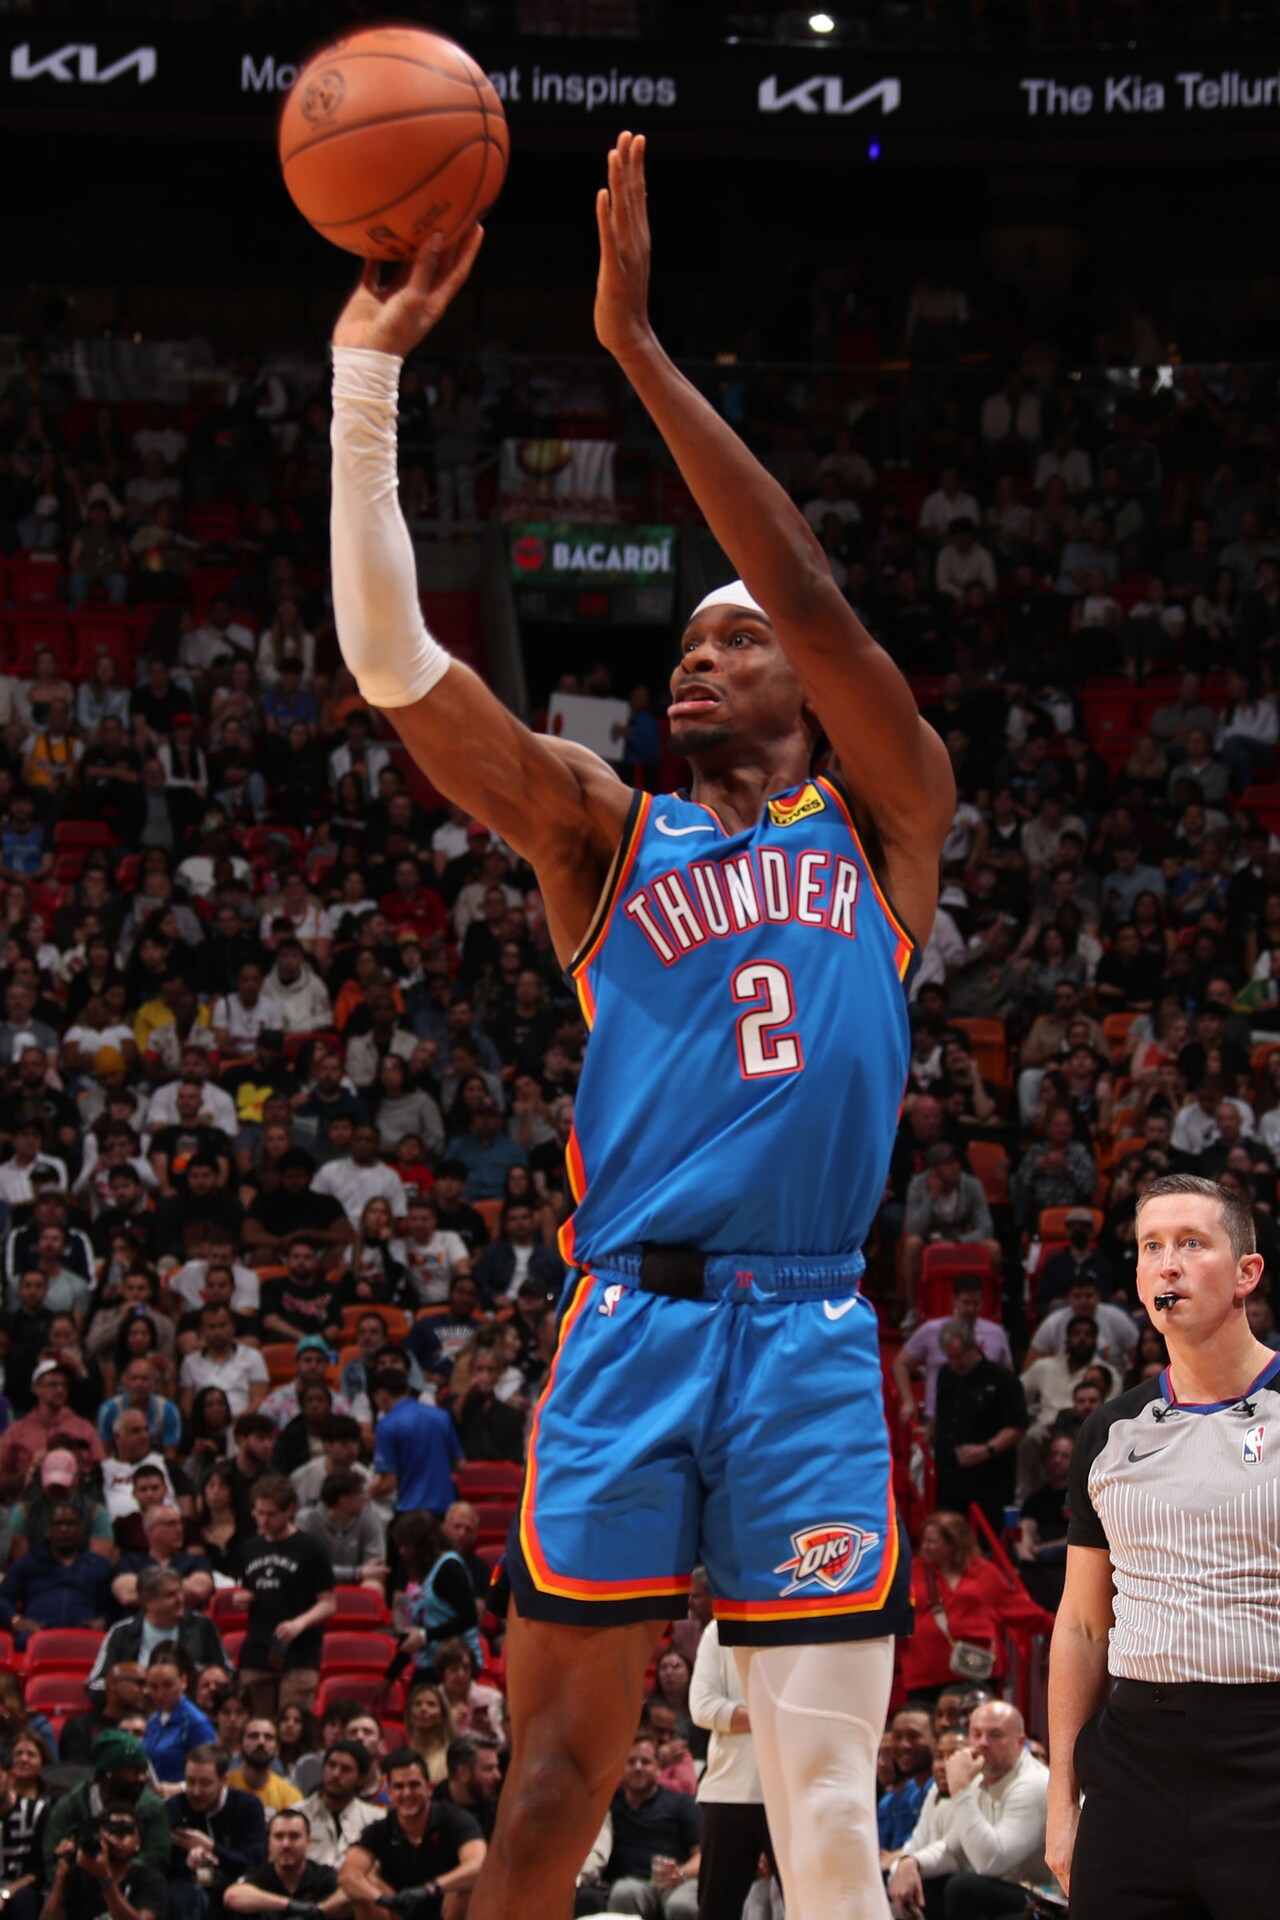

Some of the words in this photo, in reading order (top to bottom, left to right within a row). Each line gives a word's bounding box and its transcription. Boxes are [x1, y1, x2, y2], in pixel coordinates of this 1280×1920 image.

[11, 43, 156, 83] KIA
[242, 55, 298, 91] Mo
[488, 66, 519, 101] at
[532, 66, 676, 112] inspires
[758, 74, 900, 115] KIA
[1020, 78, 1093, 115] The
[1105, 75, 1165, 112] Kia
[552, 538, 672, 571] BACARDÍ
[623, 846, 861, 967] THUNDER
[730, 958, 804, 1079] 2
[797, 1535, 850, 1579] OKC
